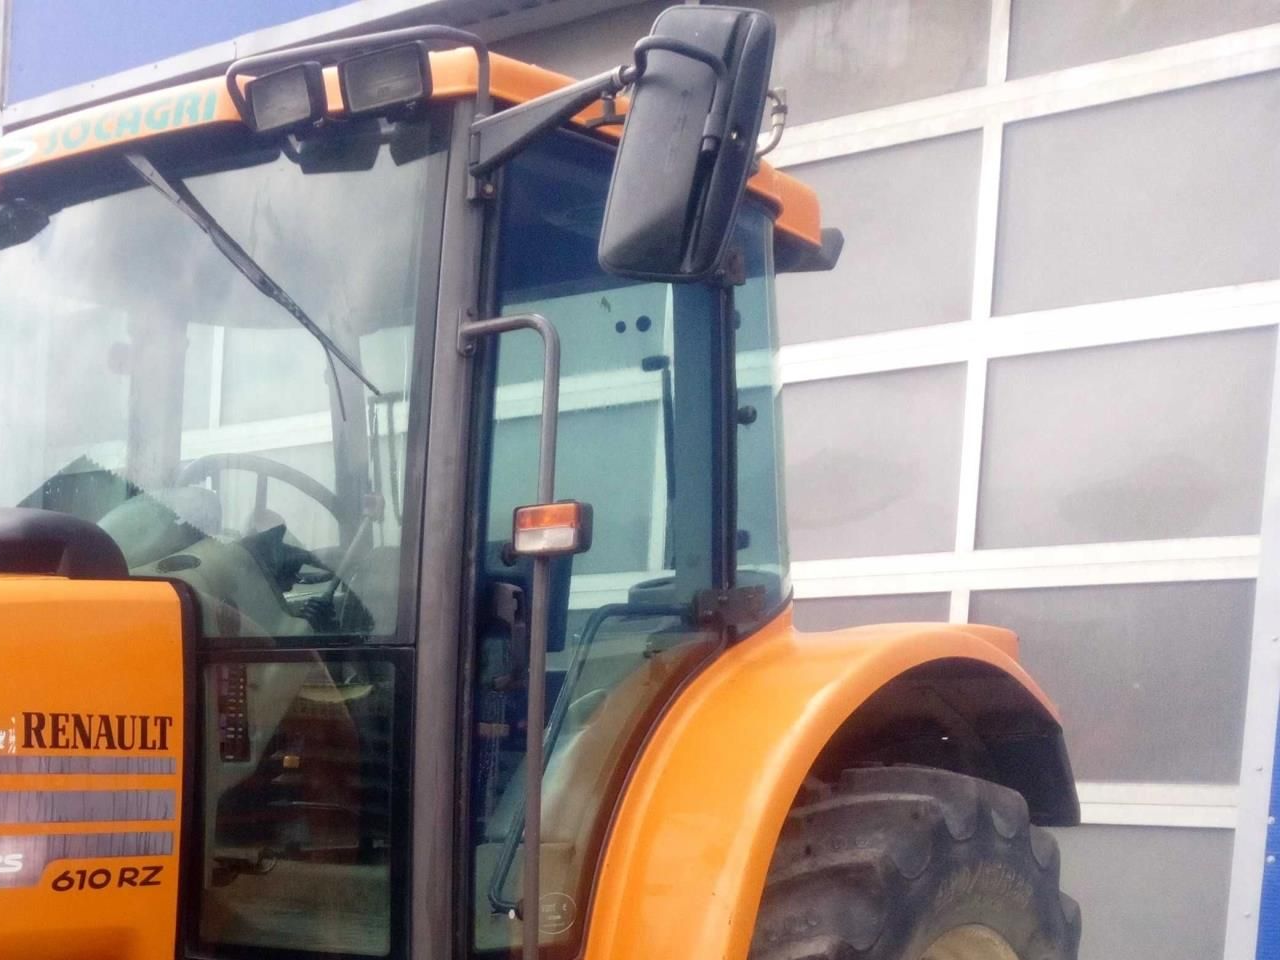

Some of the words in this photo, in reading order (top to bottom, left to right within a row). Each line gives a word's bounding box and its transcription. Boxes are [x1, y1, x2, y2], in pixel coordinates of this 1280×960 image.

[21, 711, 173, 750] RENAULT
[51, 868, 112, 892] 610
[117, 865, 164, 888] RZ
